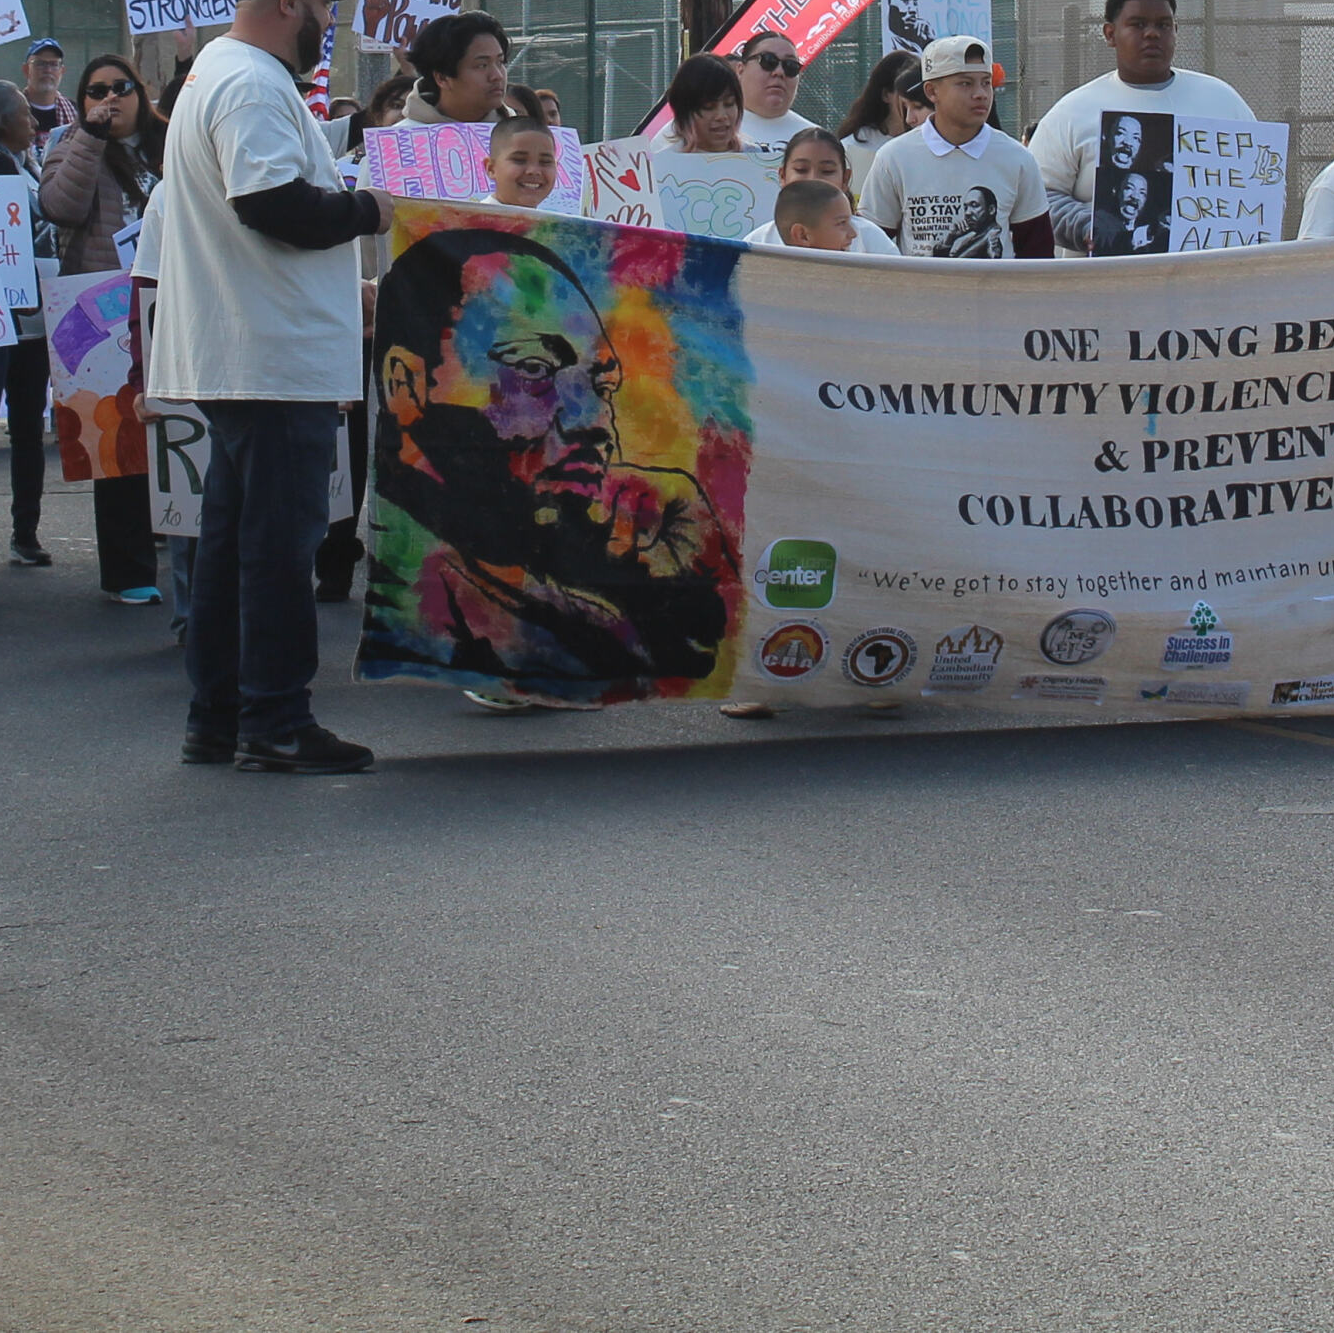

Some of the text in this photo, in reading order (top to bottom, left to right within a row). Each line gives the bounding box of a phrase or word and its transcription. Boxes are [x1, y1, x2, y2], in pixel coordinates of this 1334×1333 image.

[933, 8, 990, 42] LONG
[1178, 124, 1253, 159] KEEP
[1183, 164, 1247, 189] THE
[942, 195, 962, 204] GOT
[909, 205, 963, 217] TO STAY
[910, 216, 953, 225] TOGETHER
[1177, 196, 1264, 226] DREM
[917, 224, 950, 232] MAINTAIN
[1179, 226, 1272, 252] ALIVE
[1024, 328, 1100, 362] ONE
[1127, 325, 1258, 361] LONG
[818, 380, 1112, 416] COMMUNITY
[1094, 440, 1129, 473] &
[958, 476, 1334, 530] COLLABORATIVE
[953, 574, 991, 598] got
[998, 574, 1018, 592] to
[1026, 574, 1068, 599] stay
[1076, 570, 1163, 598] together
[1170, 569, 1207, 592] and
[1215, 561, 1310, 587] maintain
[1167, 636, 1230, 651] Success in
[934, 656, 971, 664] United
[1163, 650, 1231, 664] Challenges
[929, 673, 993, 682] Community
[931, 665, 994, 673] Cambodian
[1299, 680, 1333, 690] Justice
